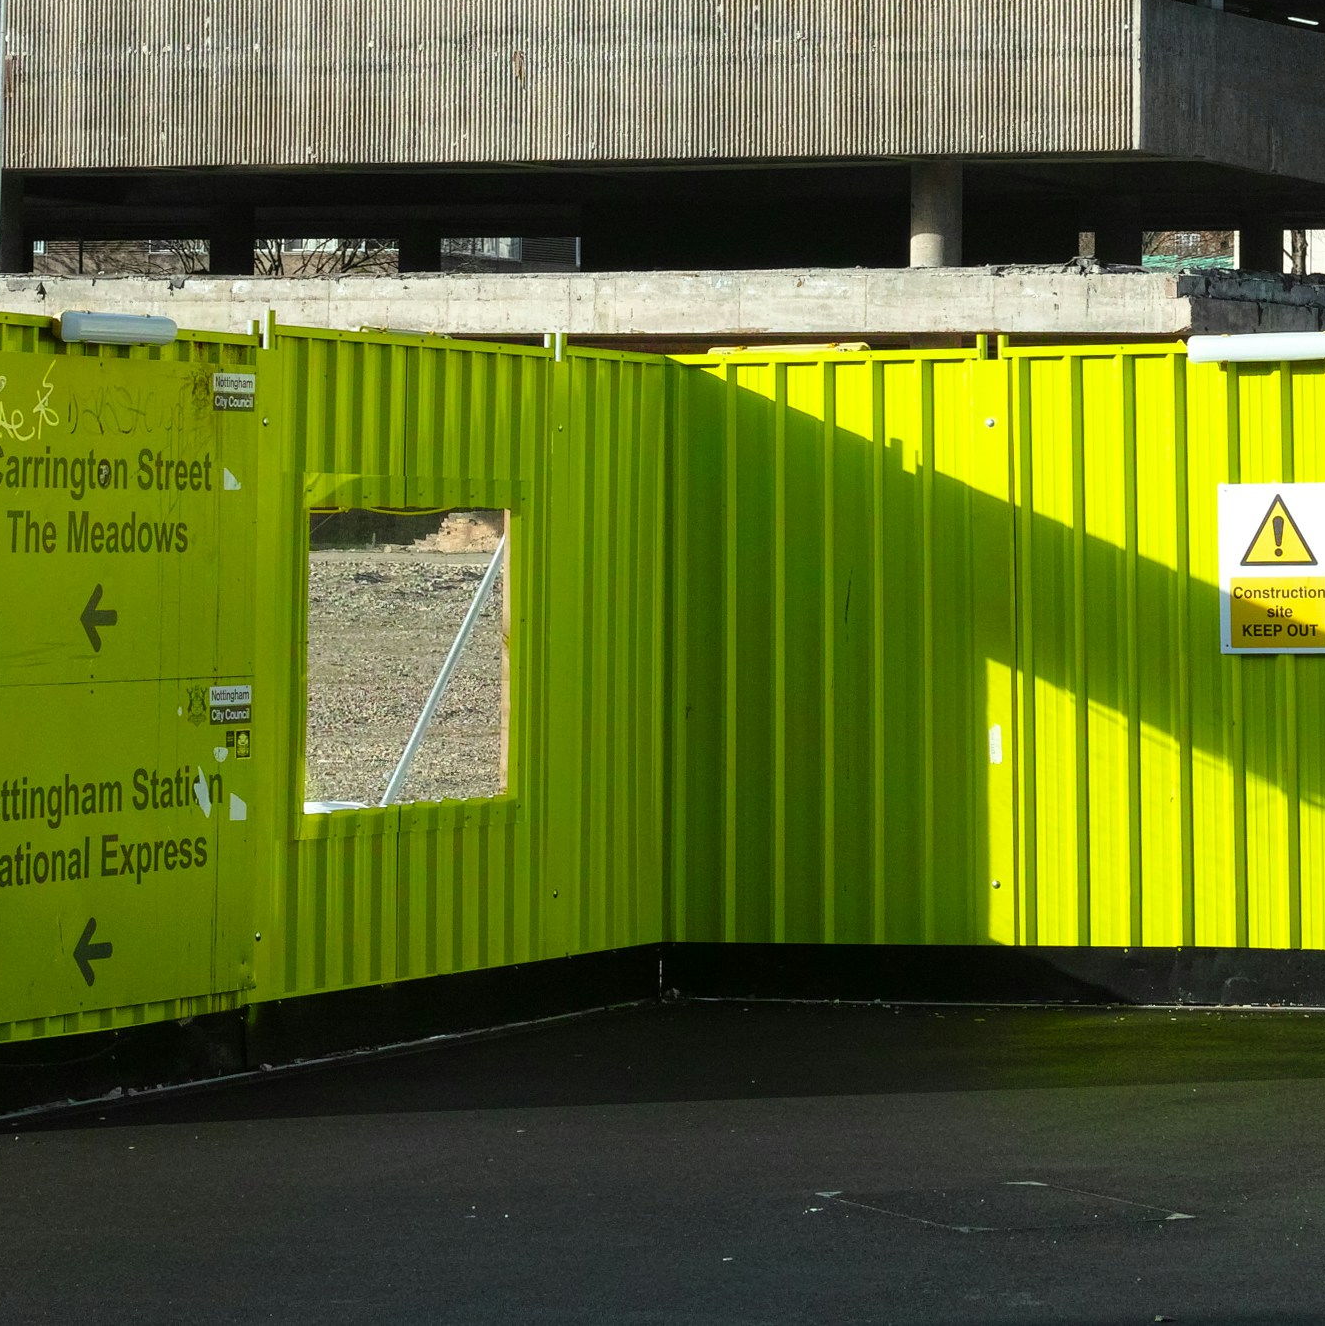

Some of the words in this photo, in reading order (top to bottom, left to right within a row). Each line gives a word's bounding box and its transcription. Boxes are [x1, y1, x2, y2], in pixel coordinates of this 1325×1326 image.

[215, 376, 254, 390] Nottingham
[215, 395, 228, 409] City
[228, 395, 254, 408] Council
[137, 448, 212, 491] Street
[7, 510, 57, 553] The
[67, 511, 189, 554] Meadows
[1233, 586, 1325, 599] Construction
[1267, 605, 1293, 618] site
[1242, 624, 1283, 637] KEEP
[1287, 624, 1318, 637] OUT
[211, 688, 250, 703] Nottingham
[211, 709, 225, 723] City
[225, 708, 250, 720] Council
[101, 834, 208, 884] Express
